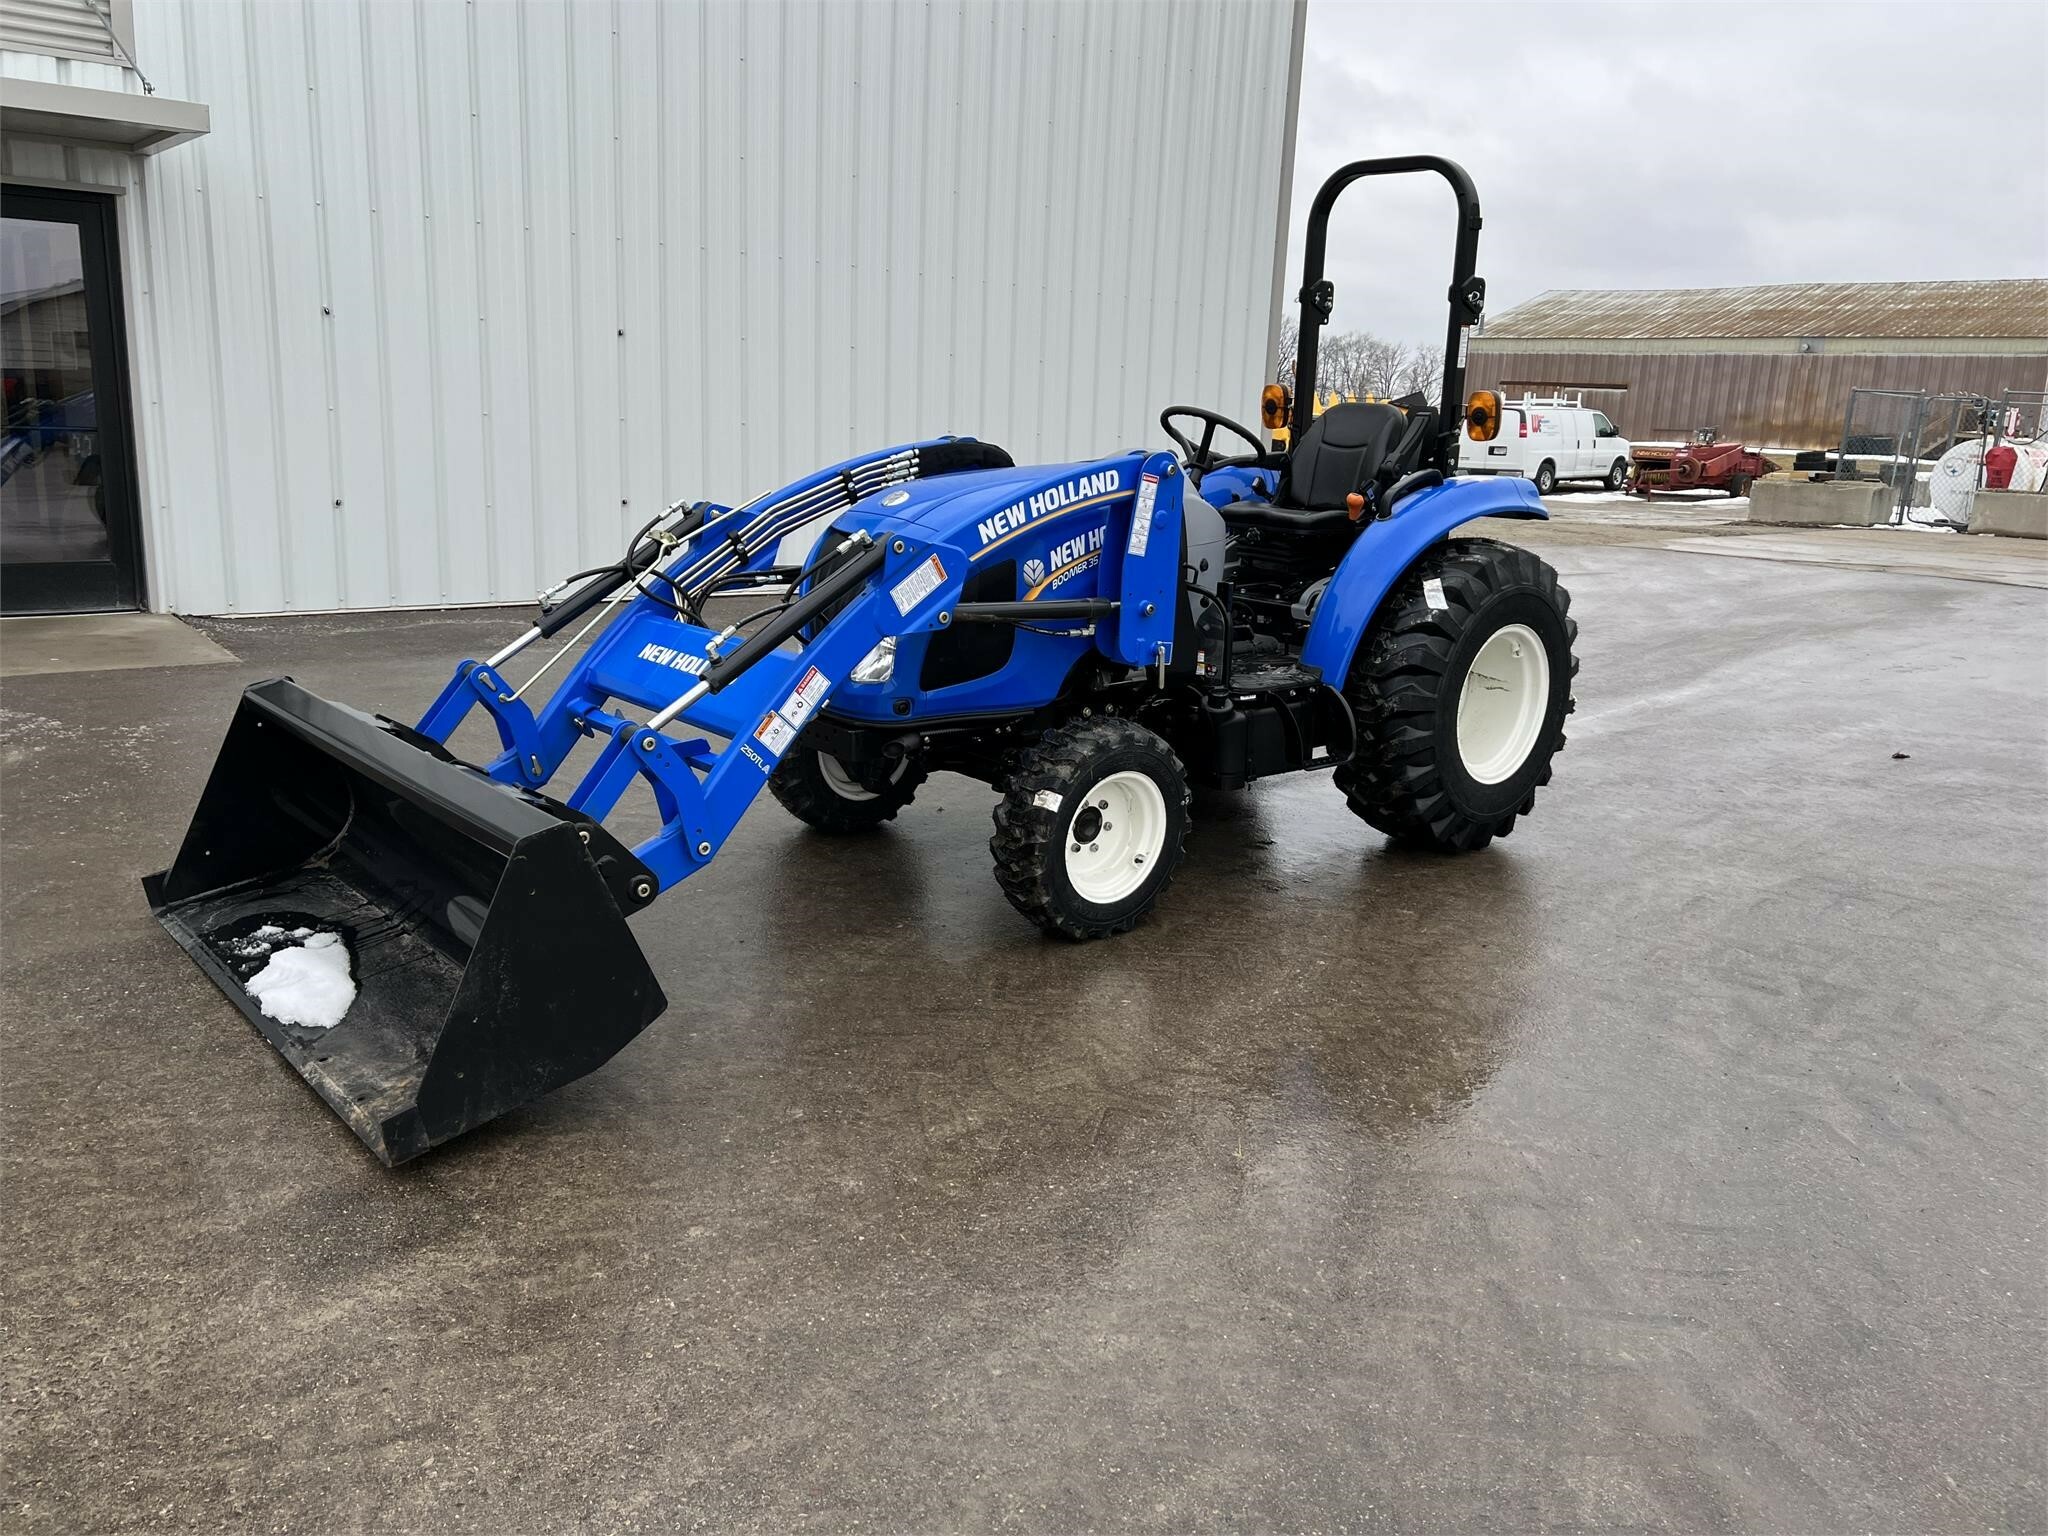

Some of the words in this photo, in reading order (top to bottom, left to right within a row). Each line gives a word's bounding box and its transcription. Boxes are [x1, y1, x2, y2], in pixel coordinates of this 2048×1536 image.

[977, 501, 1026, 545] NEW
[1029, 469, 1119, 518] HOLLAND
[1050, 533, 1086, 572] NEW
[1052, 561, 1088, 590] BOOMER
[637, 642, 679, 666] NEW
